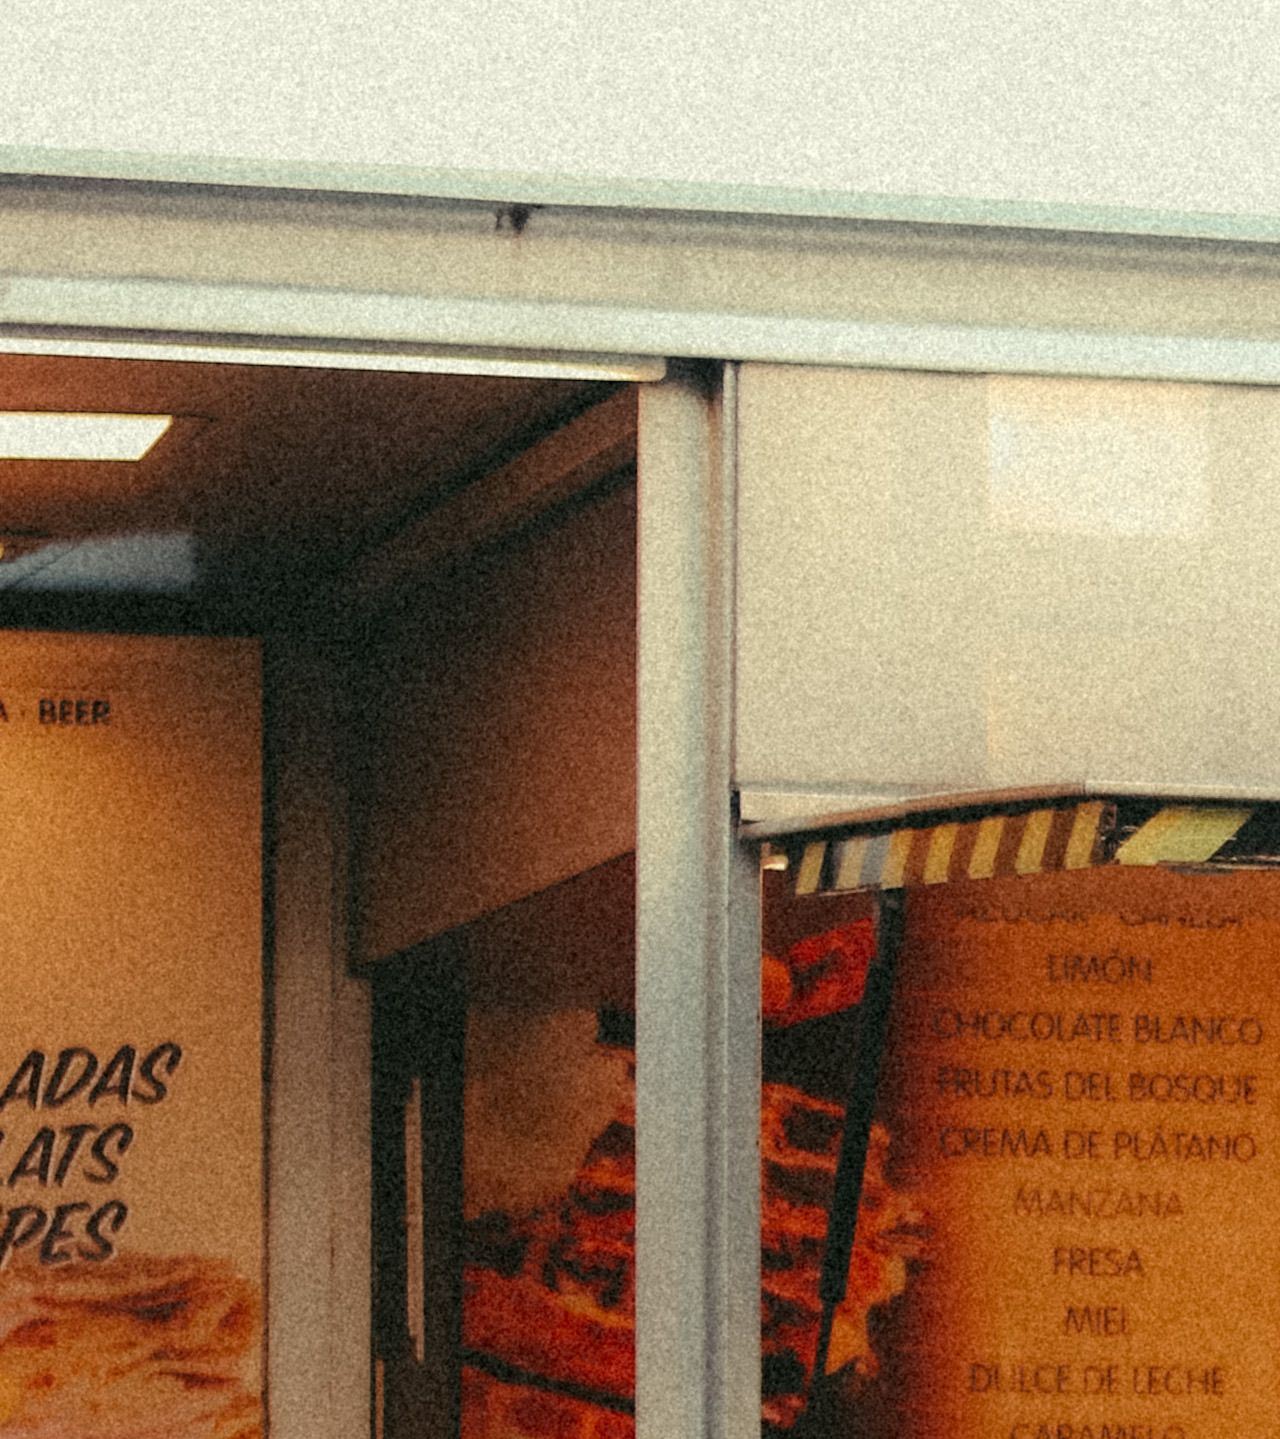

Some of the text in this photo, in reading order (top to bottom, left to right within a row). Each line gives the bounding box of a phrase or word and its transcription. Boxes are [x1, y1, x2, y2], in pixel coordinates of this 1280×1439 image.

[39, 698, 111, 725] BEER
[931, 1008, 1264, 1046] CHOCOLATE BLANCO
[936, 1065, 1258, 1106] FRUTAS DEL BOSQUE
[0, 1123, 134, 1188] ATS
[938, 1126, 1052, 1158] CREMA
[1063, 1130, 1104, 1159] DE
[1013, 1188, 1184, 1219] MANZANA
[1052, 1246, 1146, 1277] FRESA
[1063, 1305, 1132, 1336] MIEL
[968, 1362, 1225, 1397] DULCE DE LECHE
